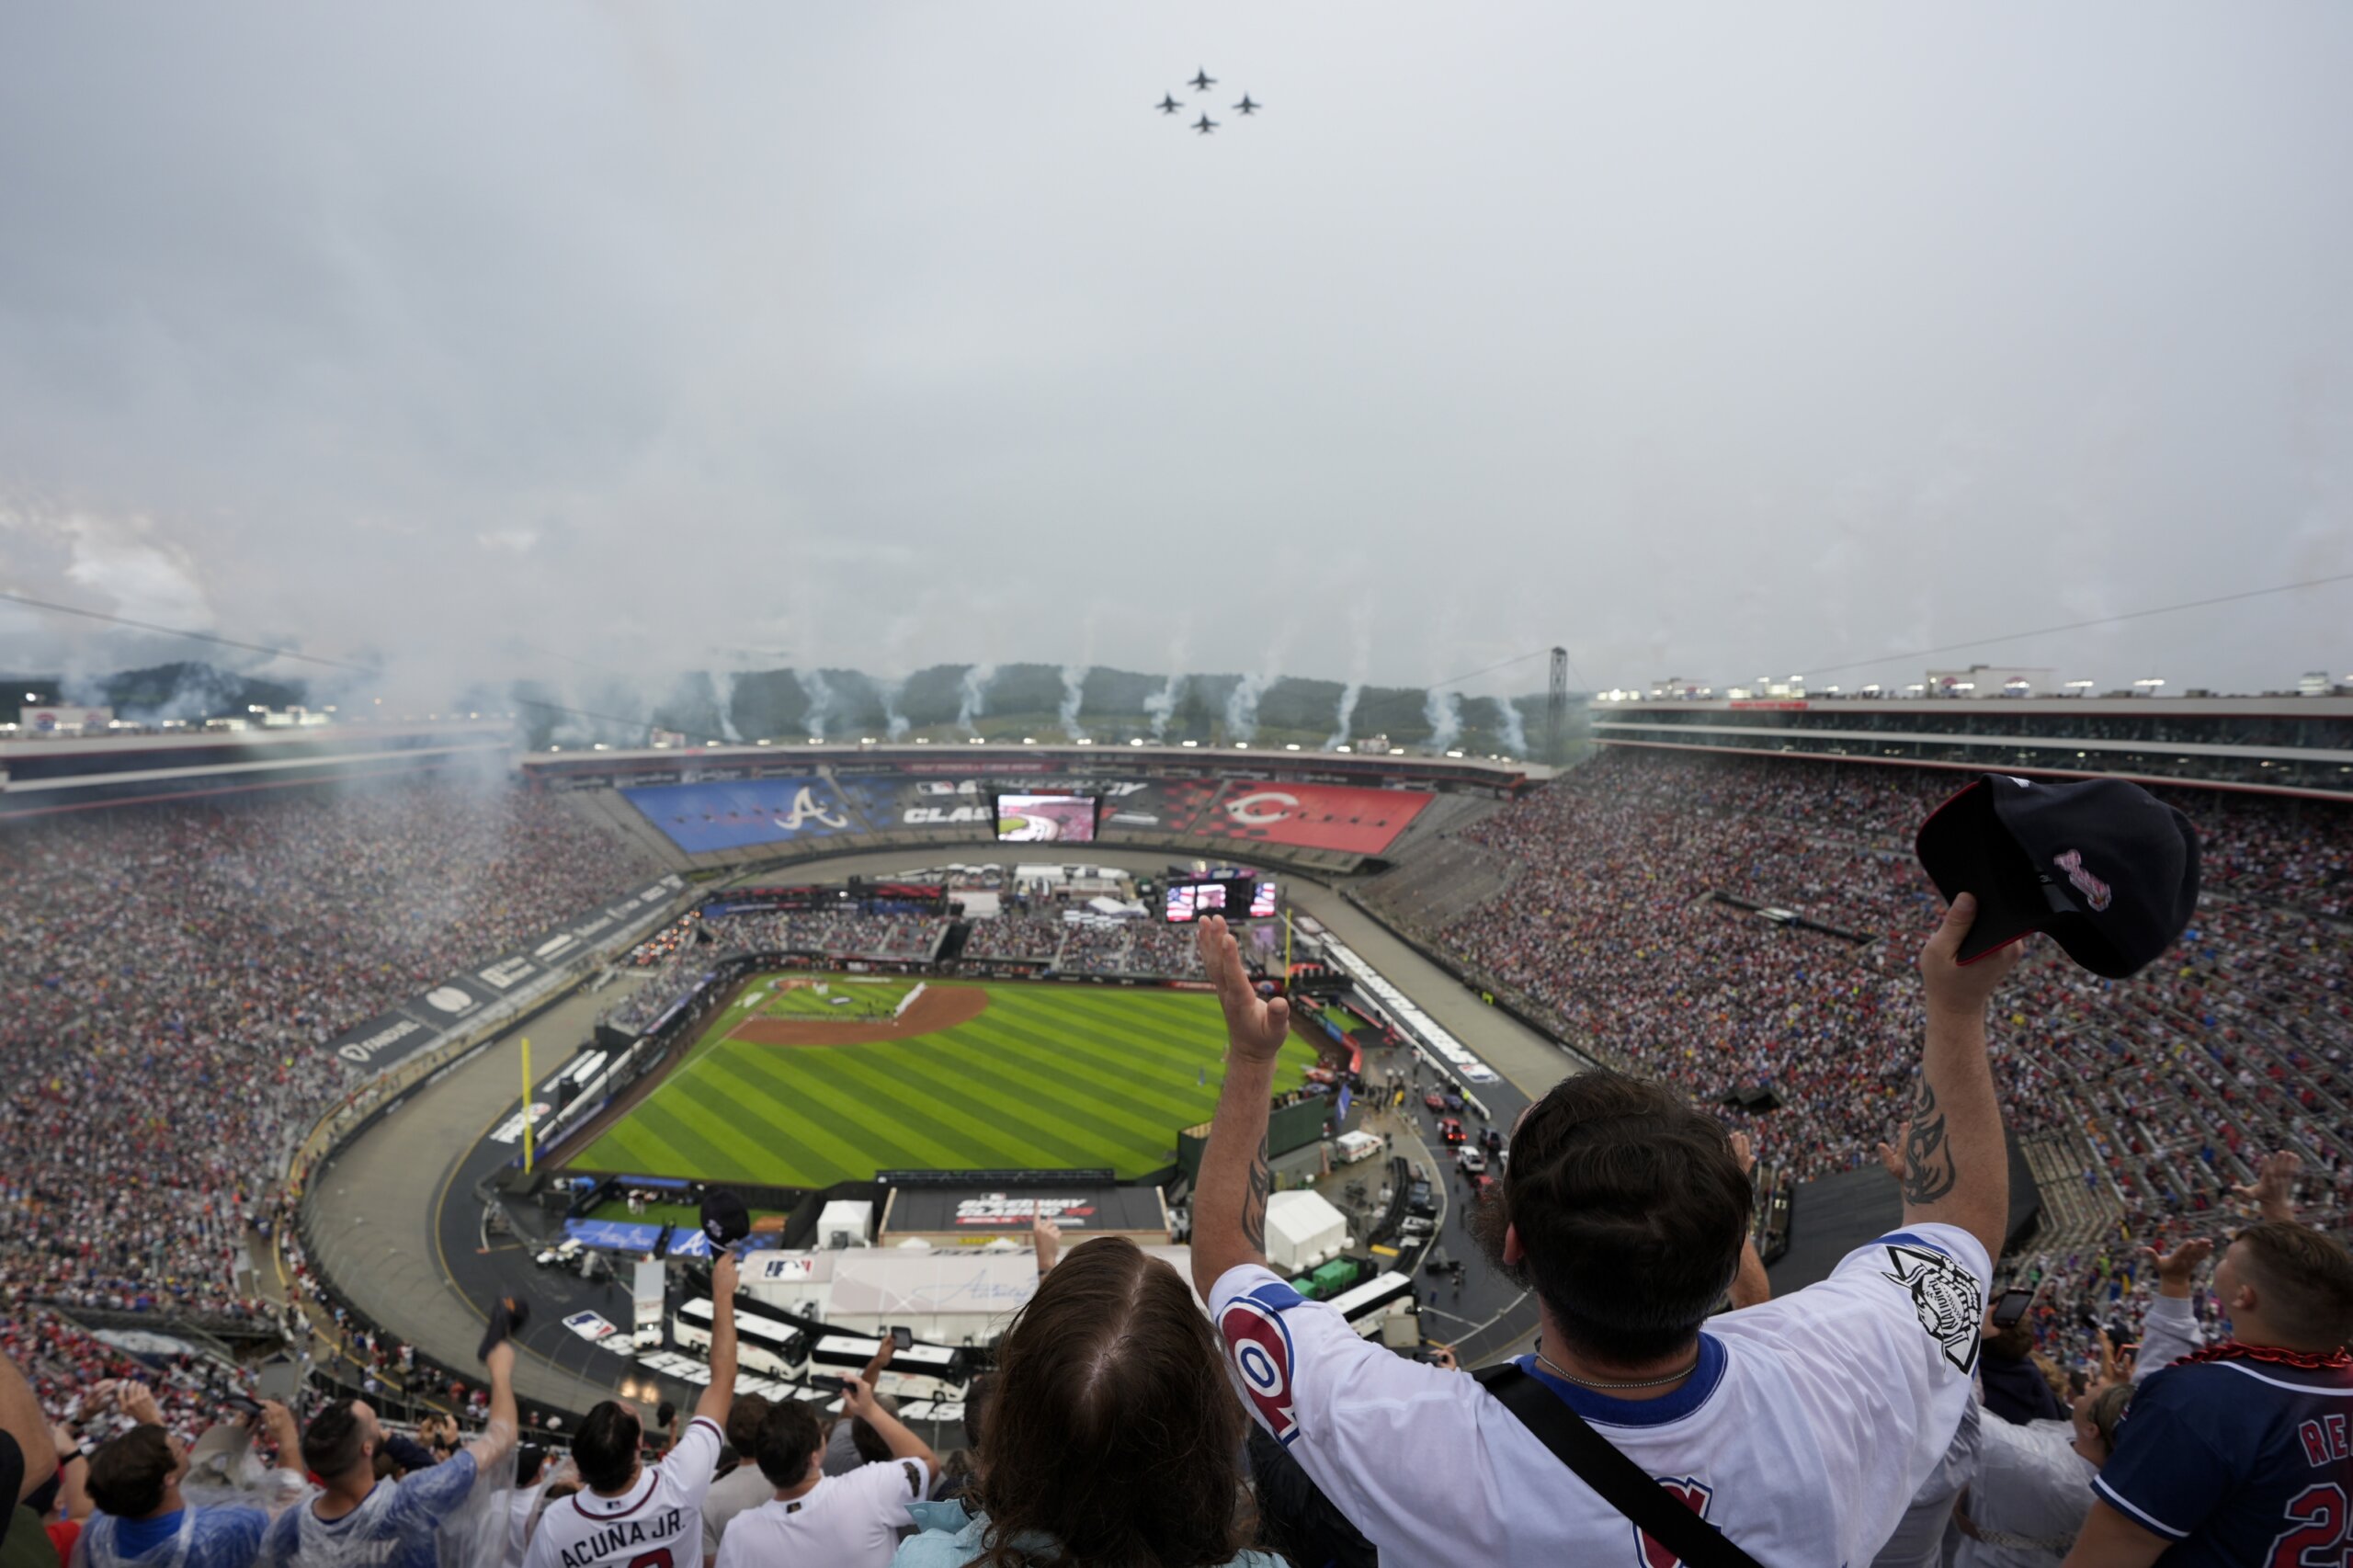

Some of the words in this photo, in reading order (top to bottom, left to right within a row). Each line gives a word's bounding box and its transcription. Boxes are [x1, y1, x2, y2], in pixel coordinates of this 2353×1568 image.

[903, 805, 993, 824] CLAS
[2298, 1414, 2353, 1468] RE
[652, 1508, 687, 1539] JR.
